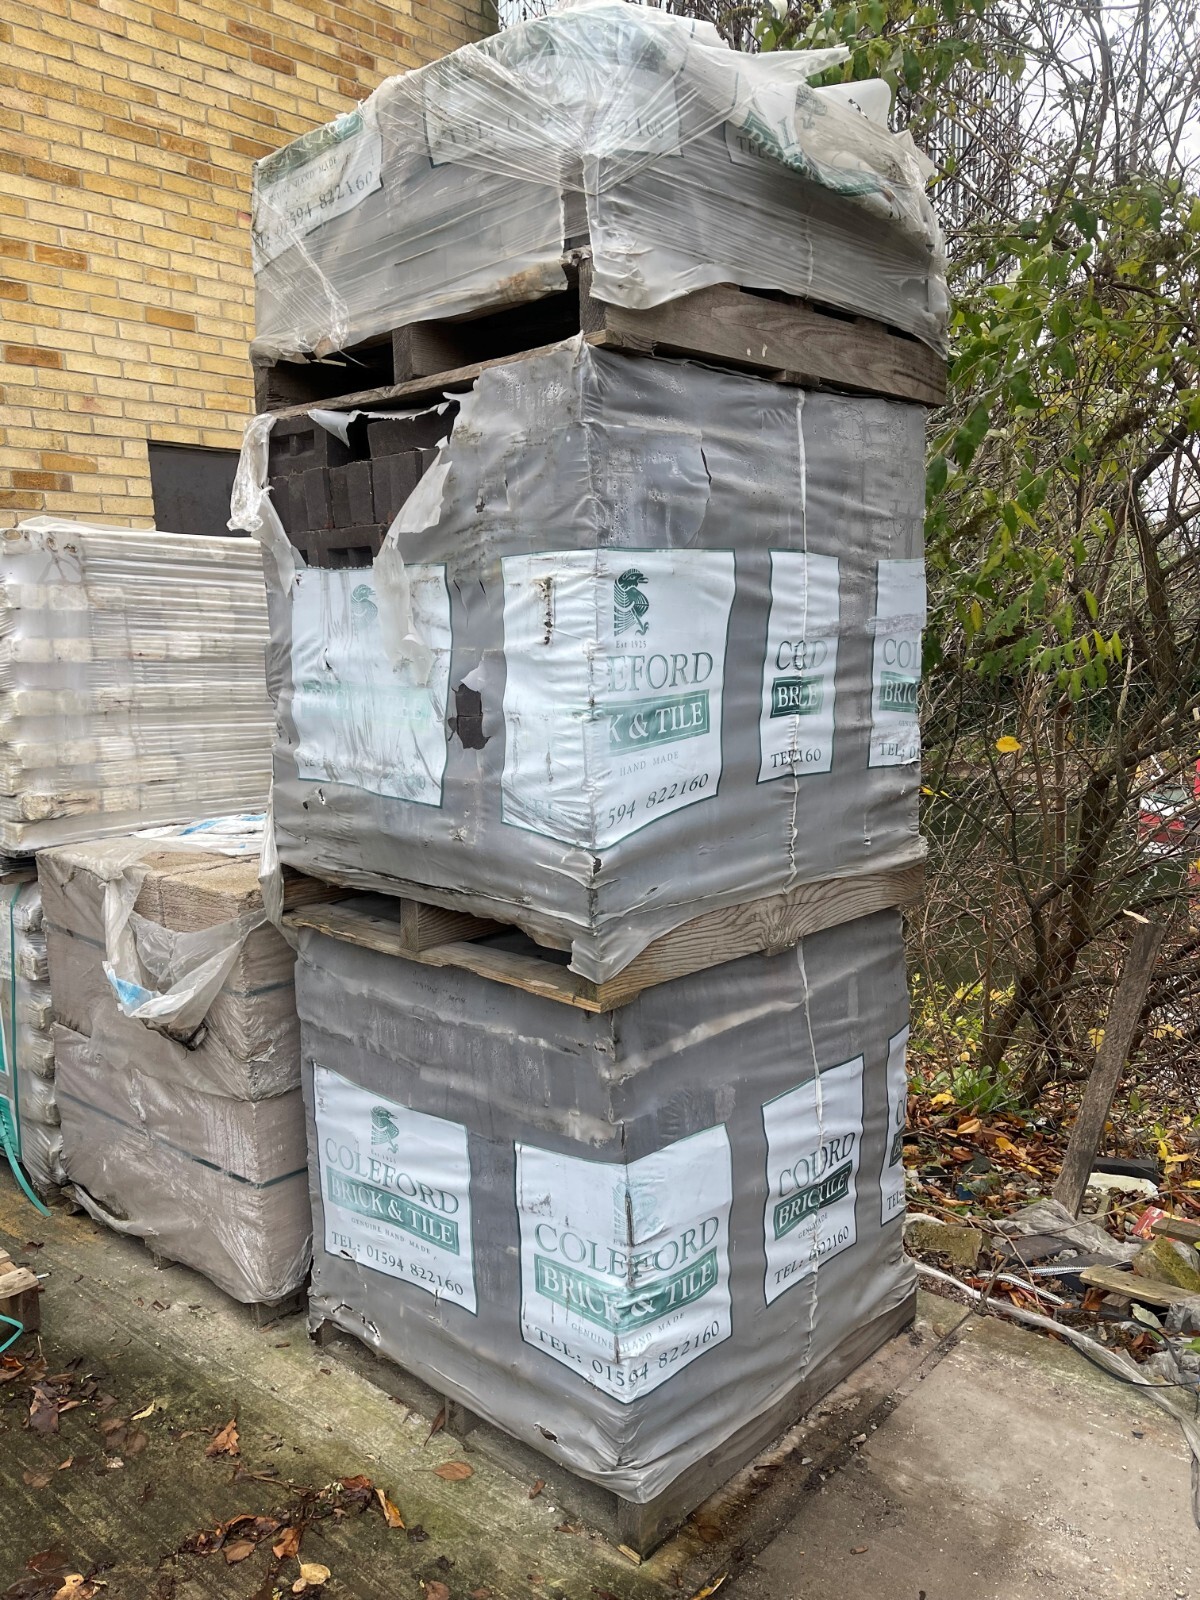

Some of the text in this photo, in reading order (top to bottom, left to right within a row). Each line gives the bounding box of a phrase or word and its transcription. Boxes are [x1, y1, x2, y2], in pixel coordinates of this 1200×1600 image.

[319, 170, 373, 210] 822160
[615, 640, 647, 649] Est 1925
[628, 712, 649, 740] &
[655, 701, 704, 734] TILE
[620, 751, 679, 777] HAND MADE
[645, 773, 709, 809] 822160
[325, 1137, 459, 1215] COLEFORD
[331, 1174, 454, 1245] BRICK & TILE
[351, 1218, 431, 1254] GENUINE HAND MADE
[534, 1216, 720, 1279] COLEFORD
[332, 1231, 464, 1296] TEL: 01594 822160
[774, 1259, 804, 1285] TEL:
[543, 1260, 714, 1325] BRICK & TILE
[535, 1320, 720, 1388] TEL: 01594 822160
[571, 1312, 686, 1355] GENUINE HAND MADE
